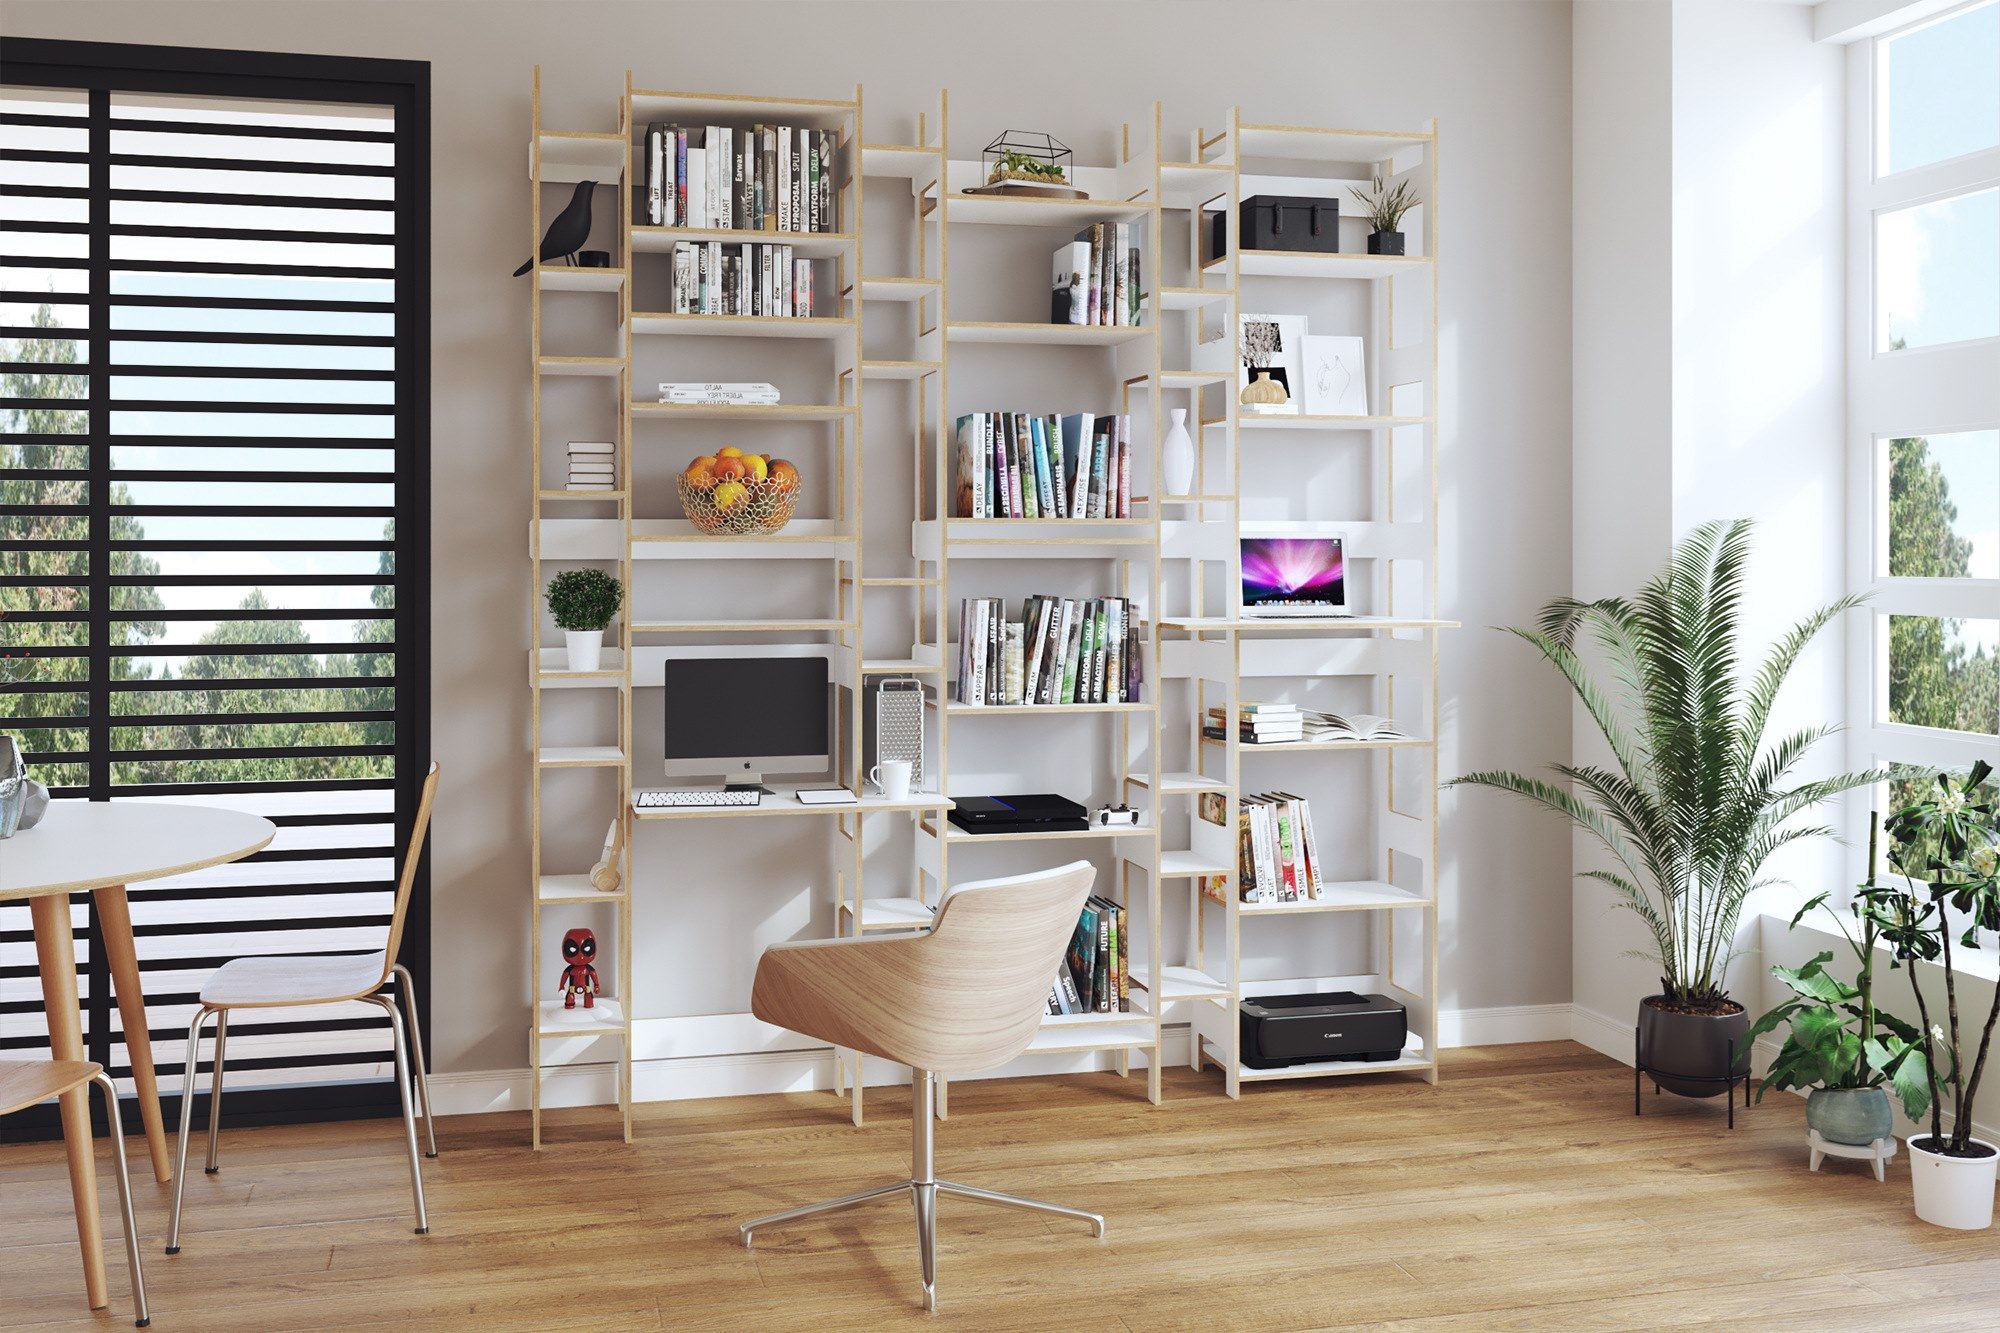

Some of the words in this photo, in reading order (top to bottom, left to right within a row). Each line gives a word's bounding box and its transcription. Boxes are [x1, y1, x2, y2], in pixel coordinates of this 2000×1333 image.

[735, 154, 743, 182] Earwax
[1055, 464, 1064, 505] EMPHASIS
[1078, 478, 1086, 506] EXCUSE
[998, 618, 1006, 642] Series
[1050, 606, 1060, 639] GUTTER
[976, 664, 984, 692] APPEAR
[1081, 650, 1092, 692] PLATFORM
[1094, 650, 1104, 692] REACTION
[1297, 868, 1306, 890] SMILE
[1312, 866, 1322, 888] TEMPT
[1100, 920, 1108, 952] FUTURE
[1062, 976, 1076, 1003] Speech
